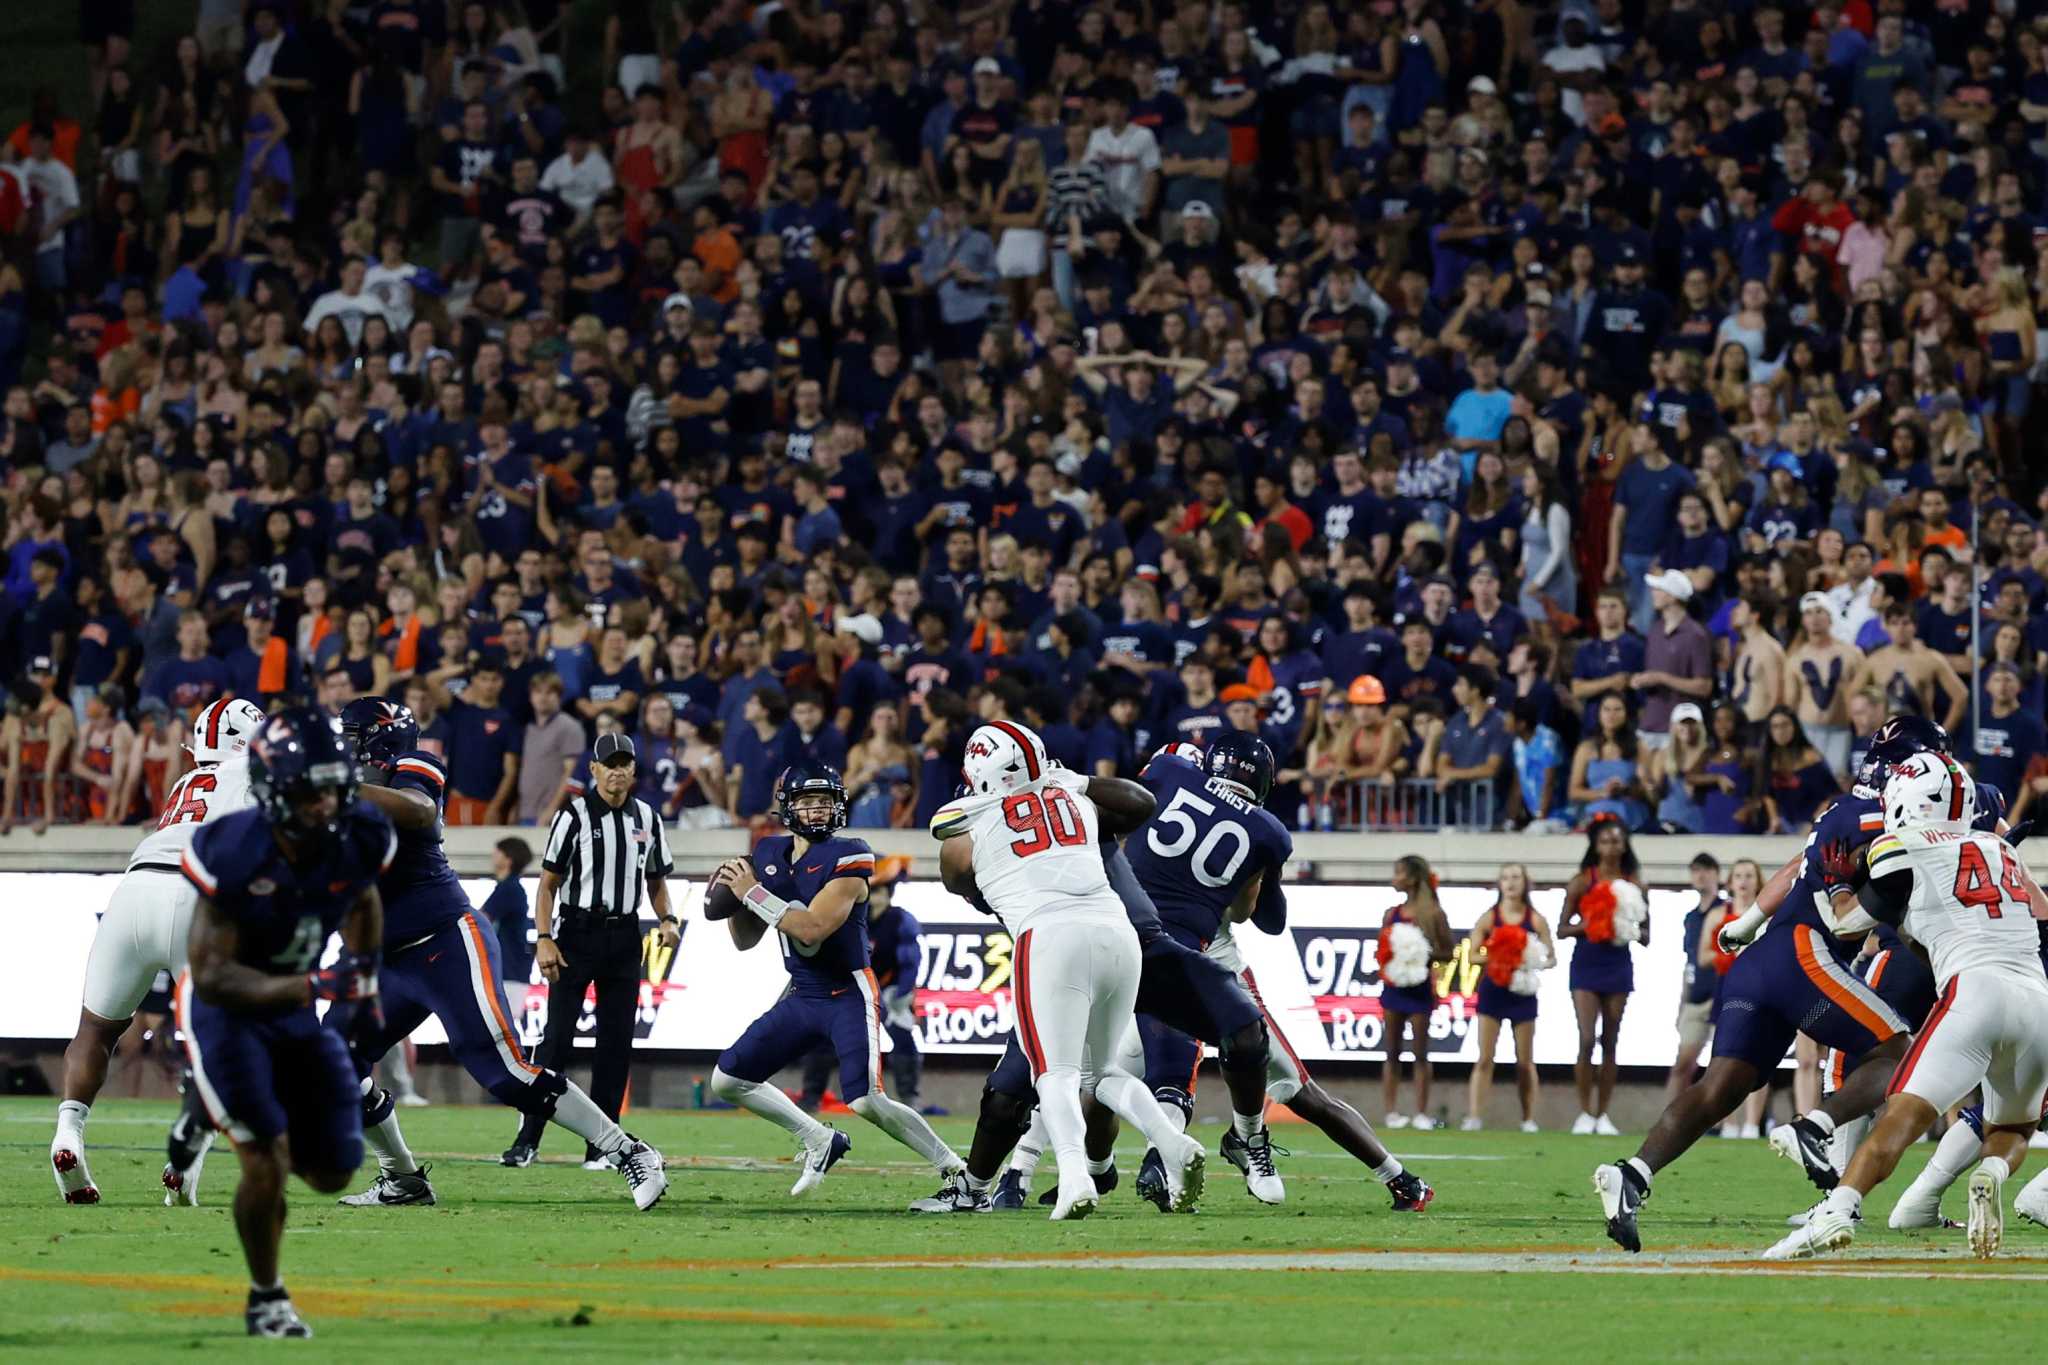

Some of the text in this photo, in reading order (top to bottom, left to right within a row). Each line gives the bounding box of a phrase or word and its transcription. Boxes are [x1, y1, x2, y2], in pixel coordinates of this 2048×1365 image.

[1265, 686, 1295, 727] 3
[1802, 656, 1842, 711] V
[655, 758, 679, 792] 2
[1204, 776, 1254, 816] CHRIST
[593, 829, 602, 839] S
[1002, 785, 1087, 858] 90
[1147, 787, 1250, 888] 50
[1953, 841, 2037, 919] 44
[271, 914, 322, 974] 4
[915, 933, 983, 991] 7.5
